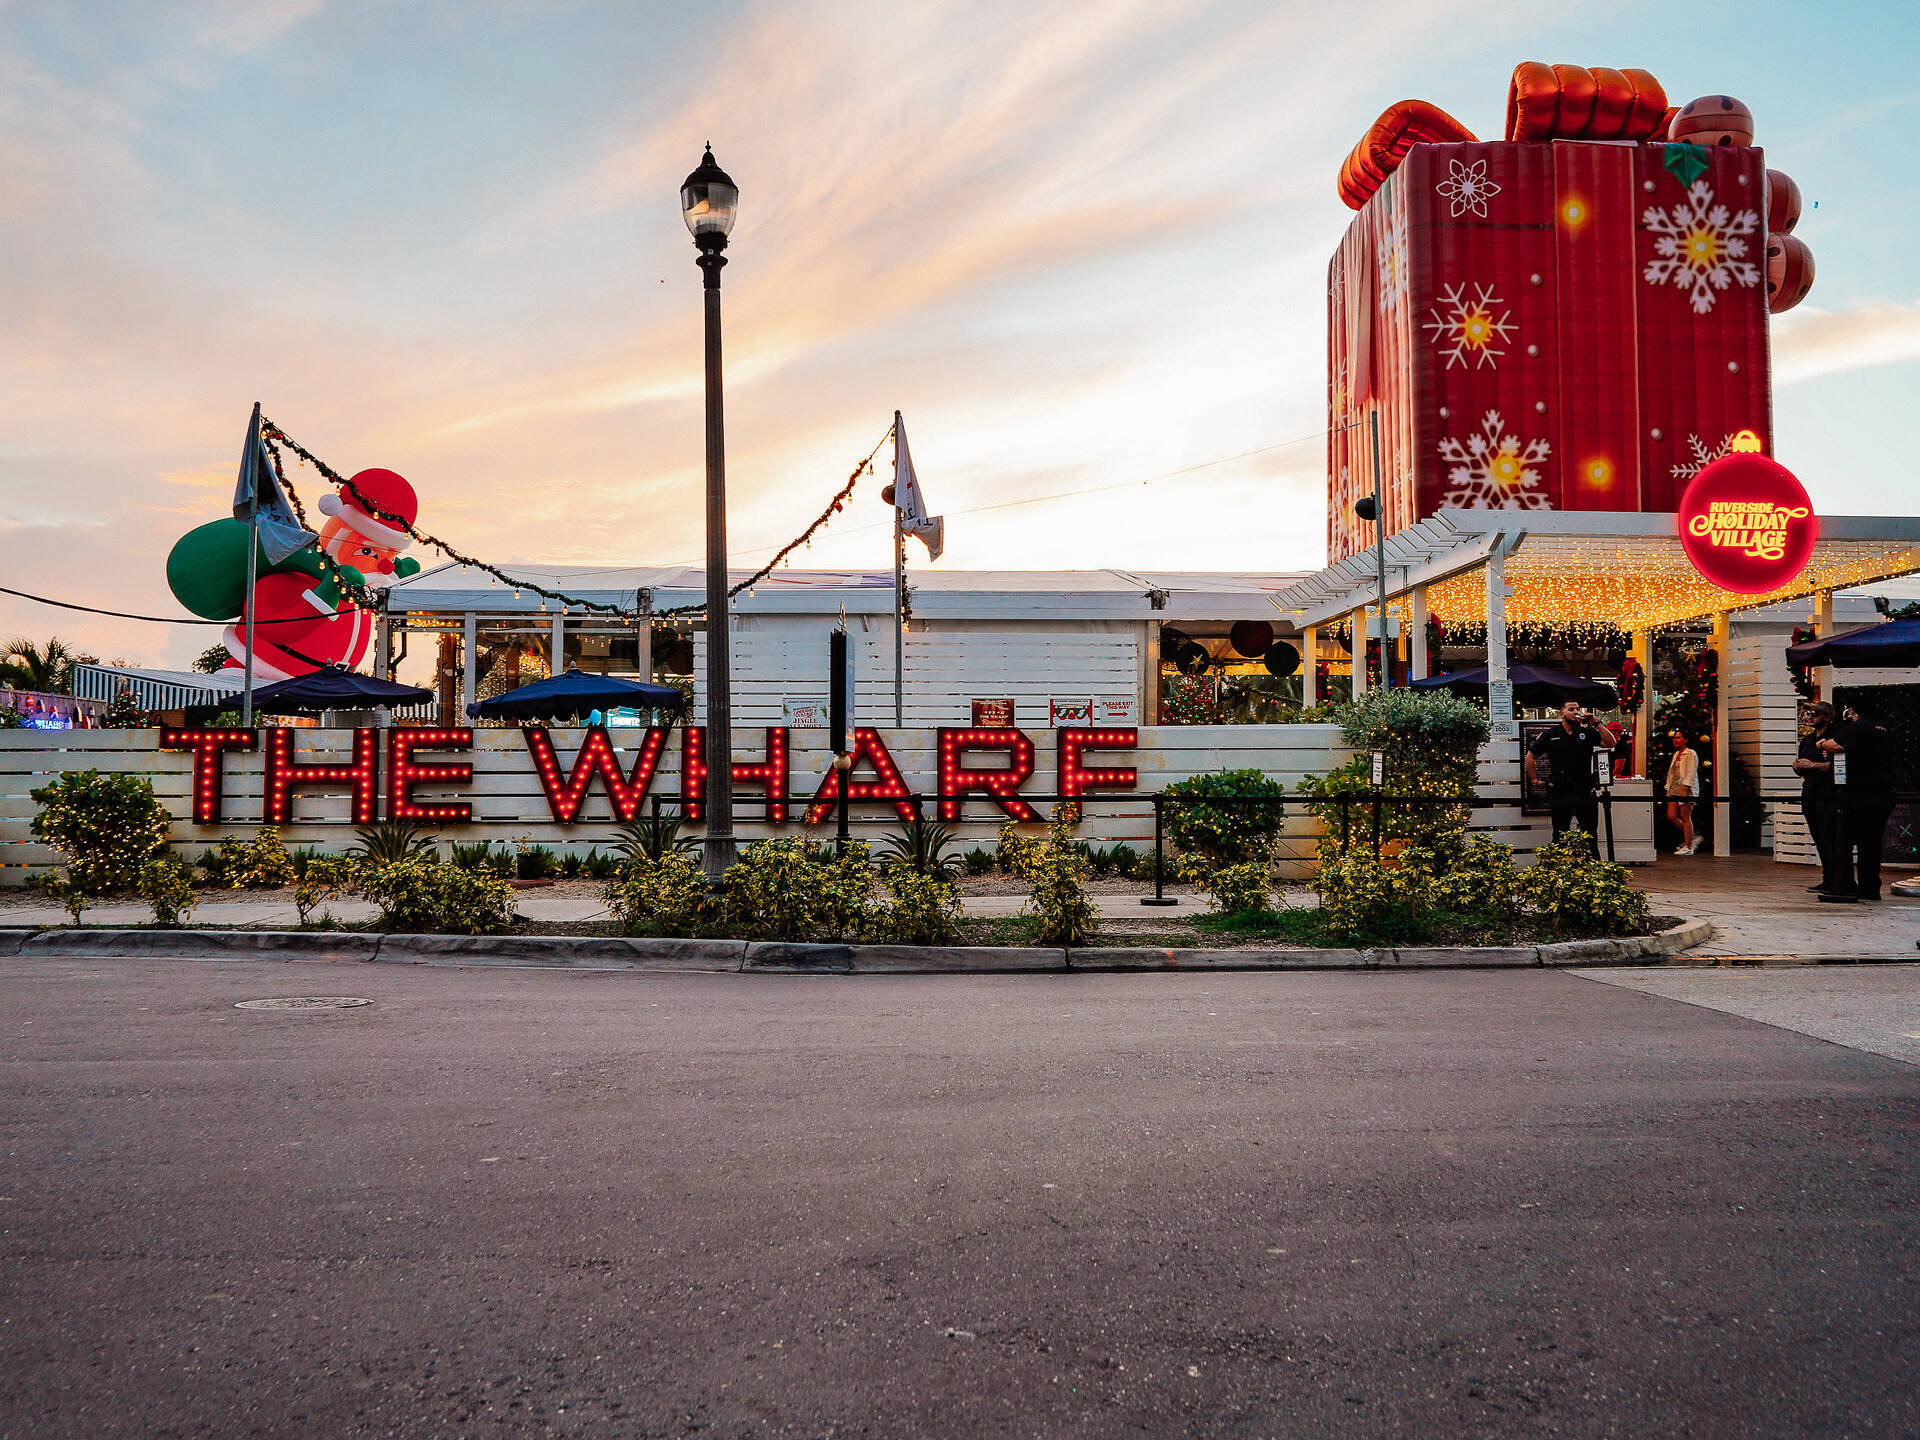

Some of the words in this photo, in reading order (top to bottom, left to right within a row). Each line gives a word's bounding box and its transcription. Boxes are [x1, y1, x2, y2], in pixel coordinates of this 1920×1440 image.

[1689, 506, 1809, 537] HOLIDAY
[1709, 502, 1775, 514] RIVERSIDE
[1711, 530, 1788, 561] VILLAGE
[159, 726, 473, 825] THE
[523, 726, 1139, 824] WHARF
